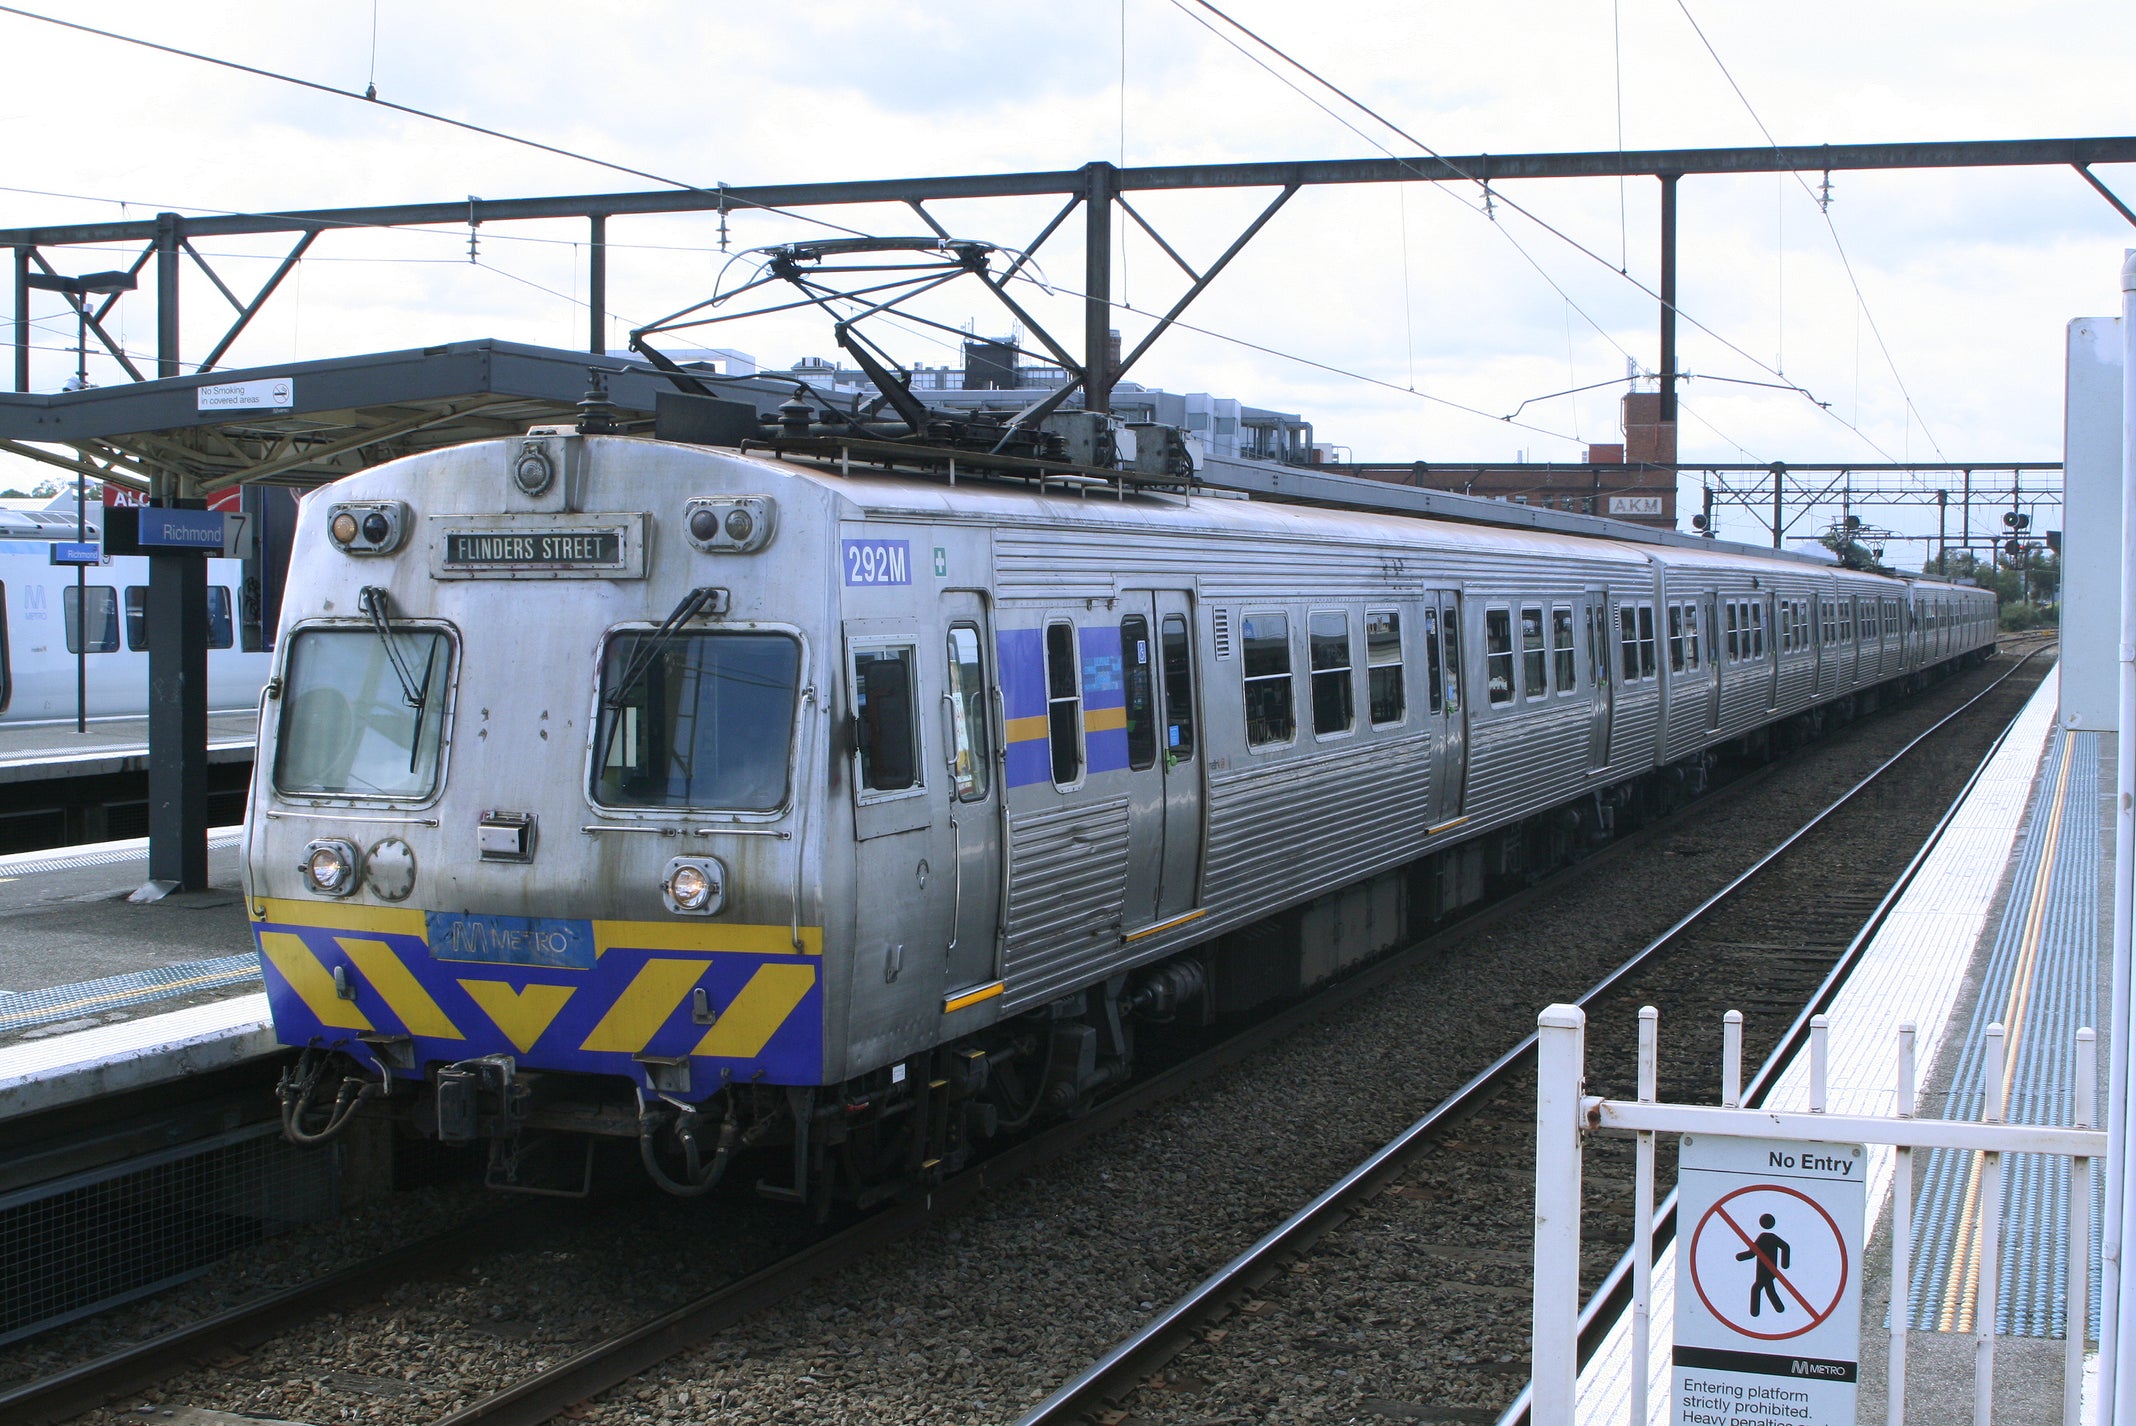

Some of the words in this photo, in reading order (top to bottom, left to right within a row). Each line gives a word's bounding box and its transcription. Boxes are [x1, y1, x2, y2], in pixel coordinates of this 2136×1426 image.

[201, 387, 212, 395] No
[213, 386, 245, 397] Smoking
[209, 396, 238, 405] covered
[163, 523, 222, 542] Richmond
[230, 515, 246, 555] 7
[67, 549, 98, 559] Richmond
[458, 537, 534, 560] FLINDERS
[542, 537, 603, 559] STREET
[849, 545, 906, 582] 292M
[491, 927, 568, 953] METRO
[1769, 1151, 1795, 1168] No
[1801, 1153, 1853, 1176] Entry
[1809, 1364, 1846, 1376] METRO
[1683, 1378, 1744, 1399] Entering
[1748, 1385, 1809, 1402] platform
[1682, 1395, 1731, 1414] strictly
[1734, 1401, 1813, 1419] prohibited.
[1682, 1410, 1727, 1426] Heavy
